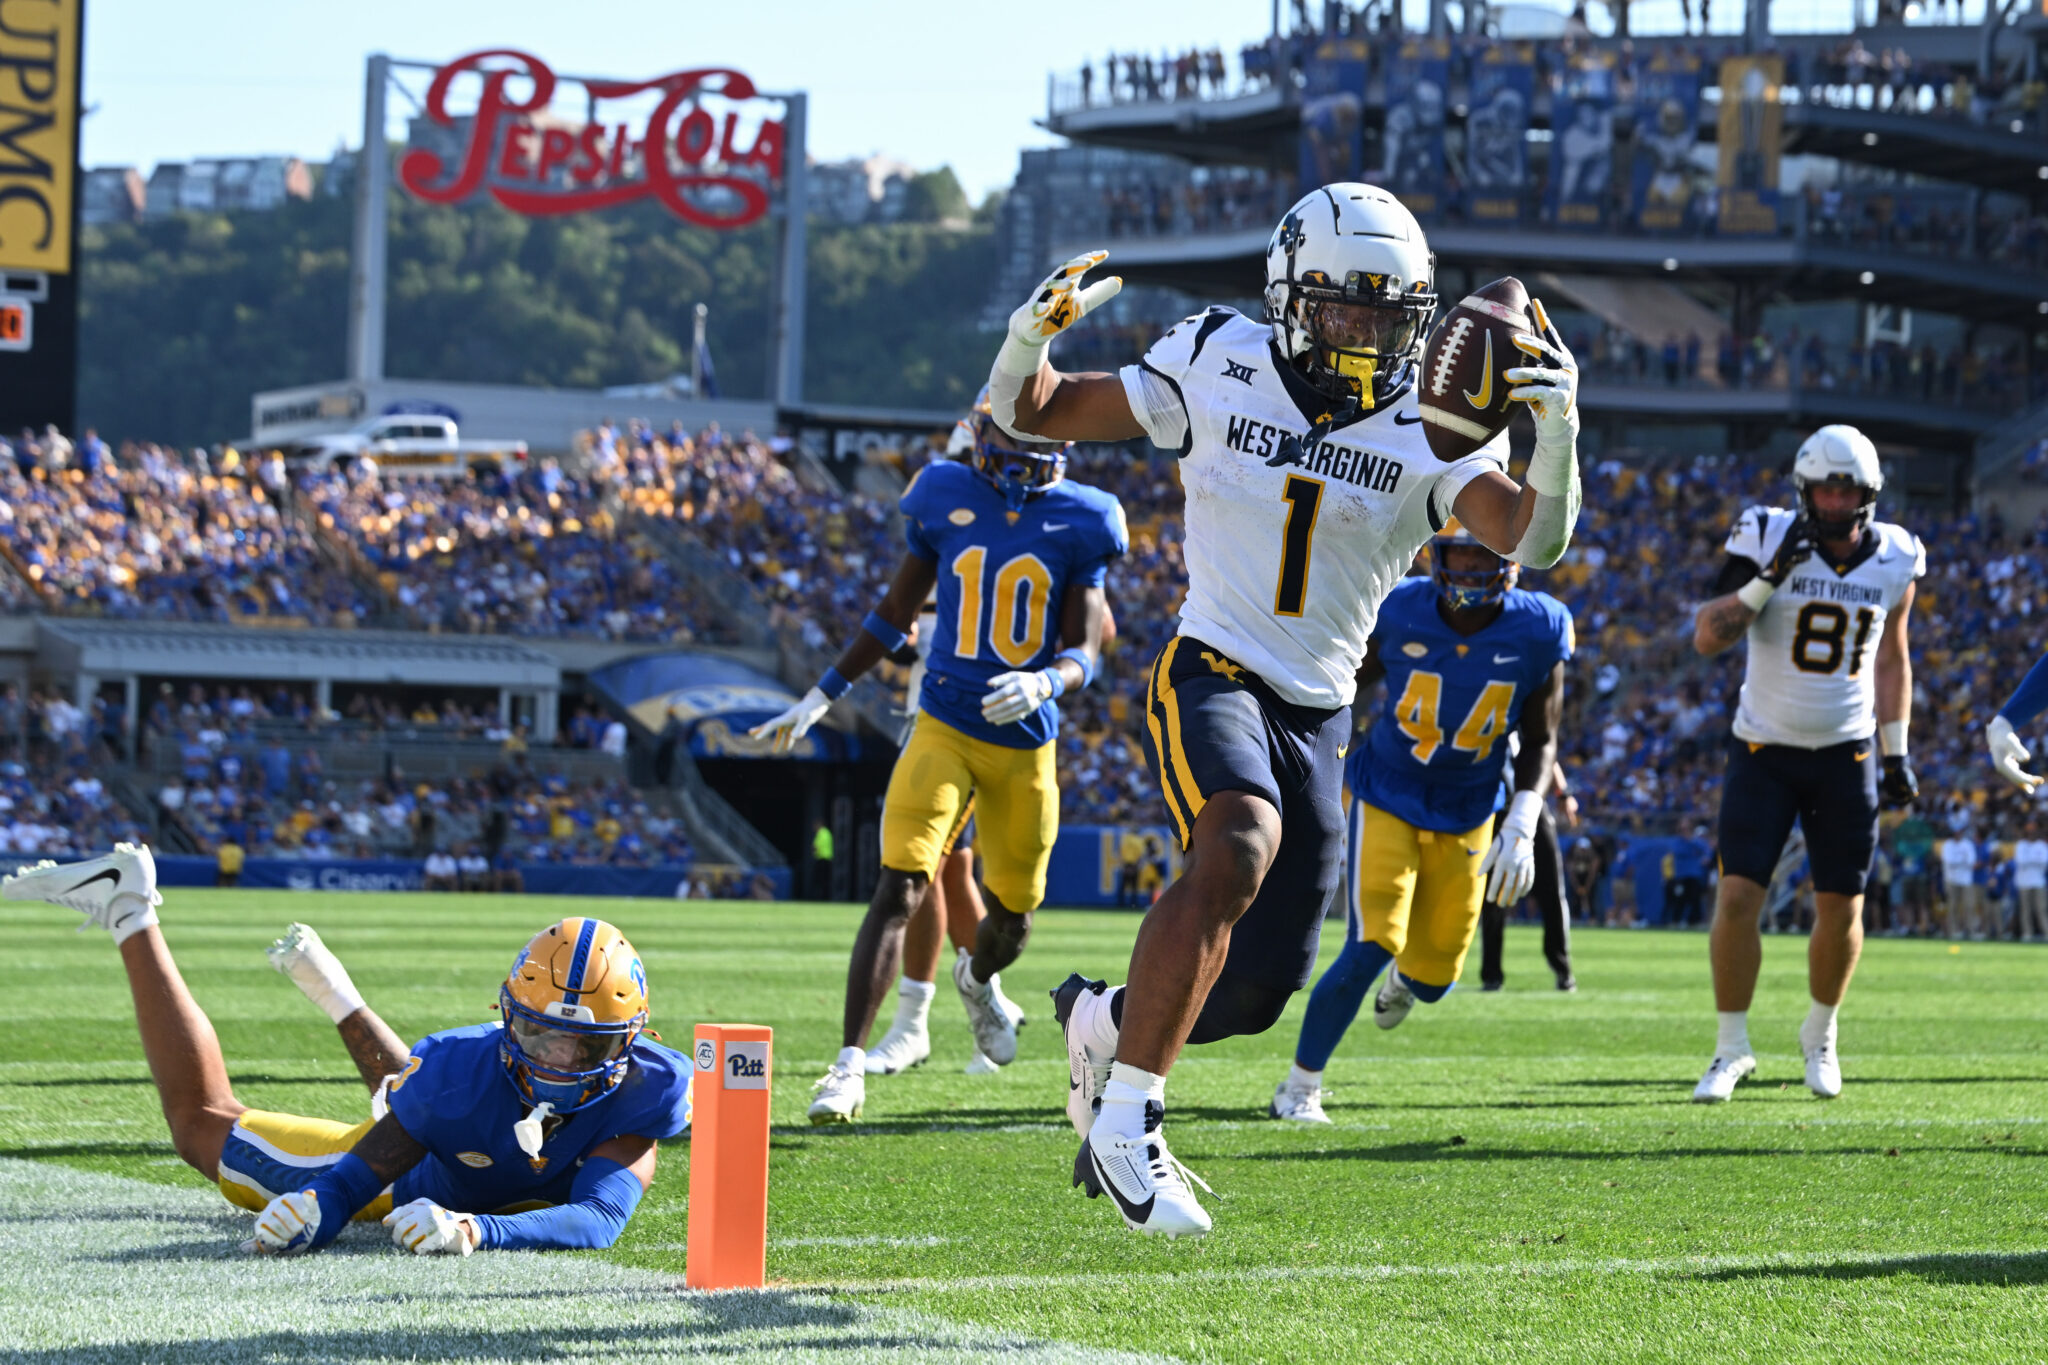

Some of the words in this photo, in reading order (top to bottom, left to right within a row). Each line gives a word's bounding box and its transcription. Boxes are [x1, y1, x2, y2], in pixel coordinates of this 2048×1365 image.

[1220, 357, 1258, 386] XII
[1226, 414, 1291, 458] WEST
[1273, 472, 1327, 618] 1
[952, 545, 1054, 668] 10
[1791, 576, 1825, 597] WEST
[1791, 600, 1875, 681] 81
[1394, 669, 1517, 766] 44
[699, 1049, 712, 1059] ACC
[727, 1053, 765, 1077] Pitt
